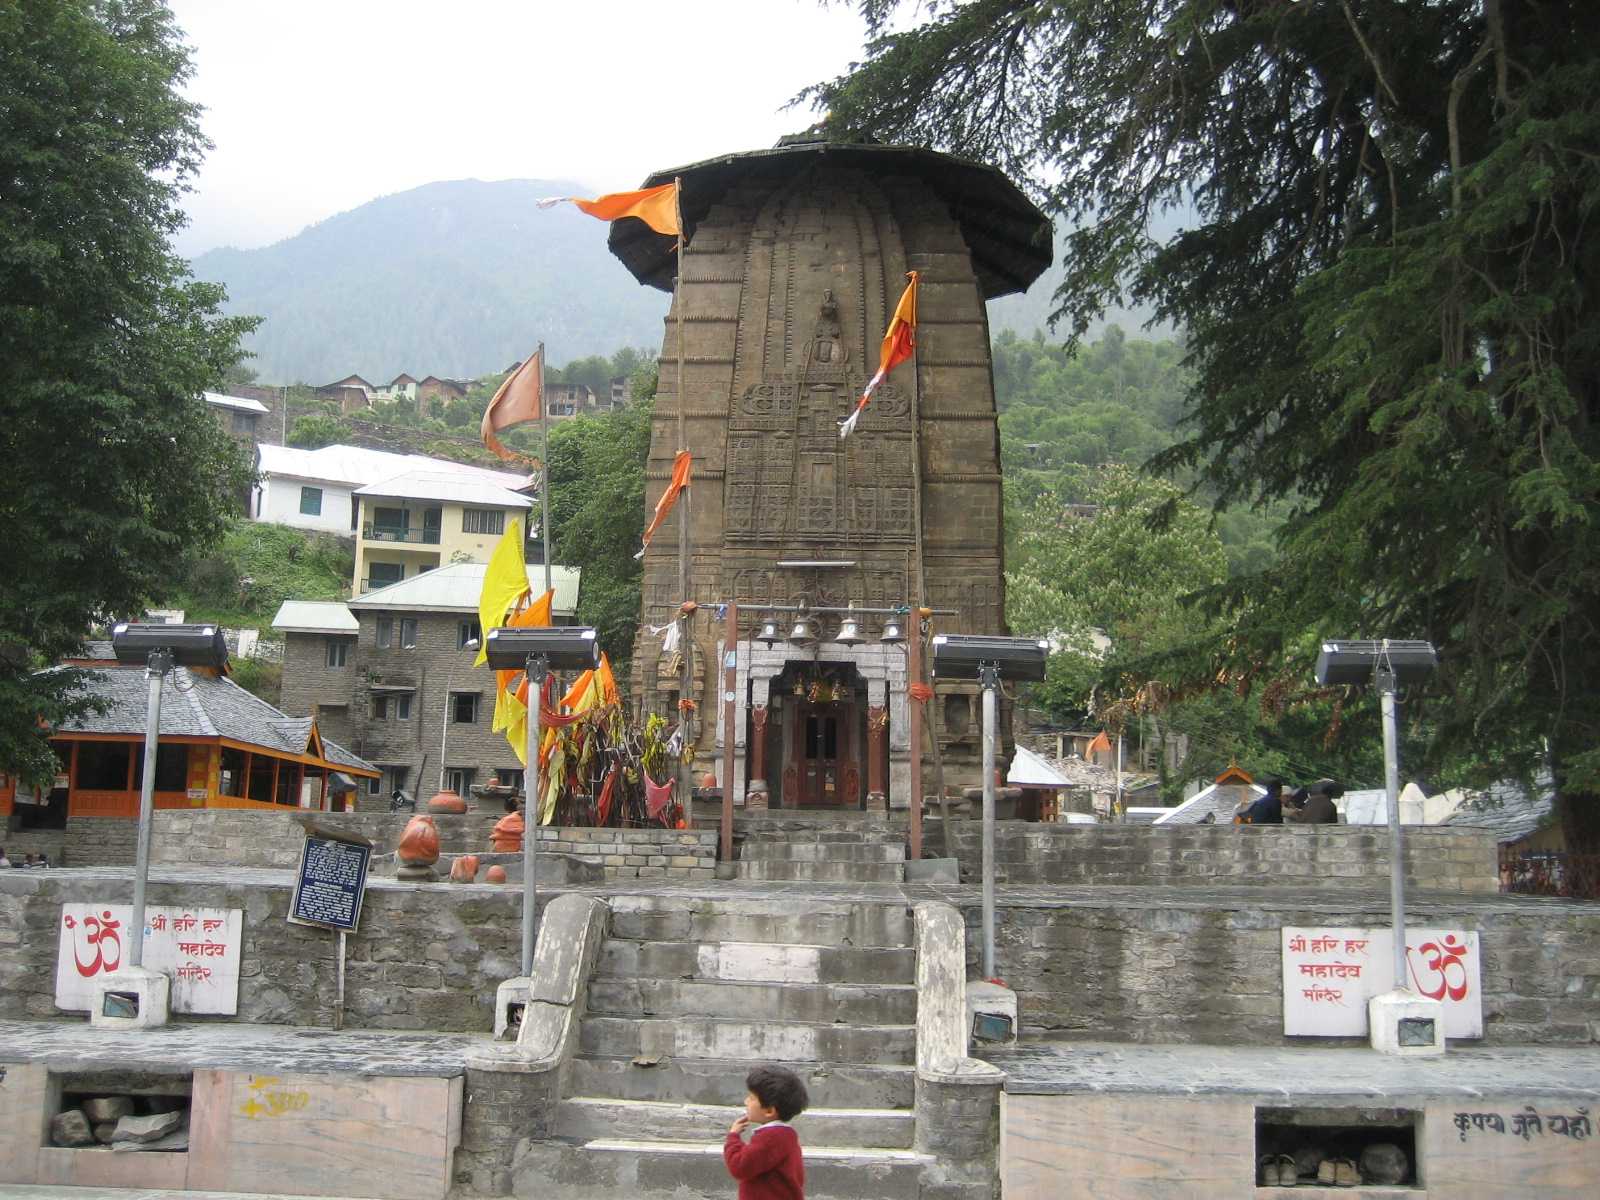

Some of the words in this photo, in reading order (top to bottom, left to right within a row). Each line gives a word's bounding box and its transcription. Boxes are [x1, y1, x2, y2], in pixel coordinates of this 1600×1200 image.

[151, 913, 167, 931] श्री
[173, 913, 198, 932] हरि
[203, 919, 224, 933] हर
[177, 939, 226, 957] महादेव
[1288, 934, 1307, 952] श्री
[1311, 935, 1340, 953] हरि
[1344, 940, 1369, 955] हर
[176, 962, 212, 981] मन्दिर
[1298, 961, 1362, 978] महादेव
[1302, 984, 1346, 1004] मन्दिर
[1511, 1105, 1542, 1141] जूते
[1546, 1106, 1592, 1141] यहाँ
